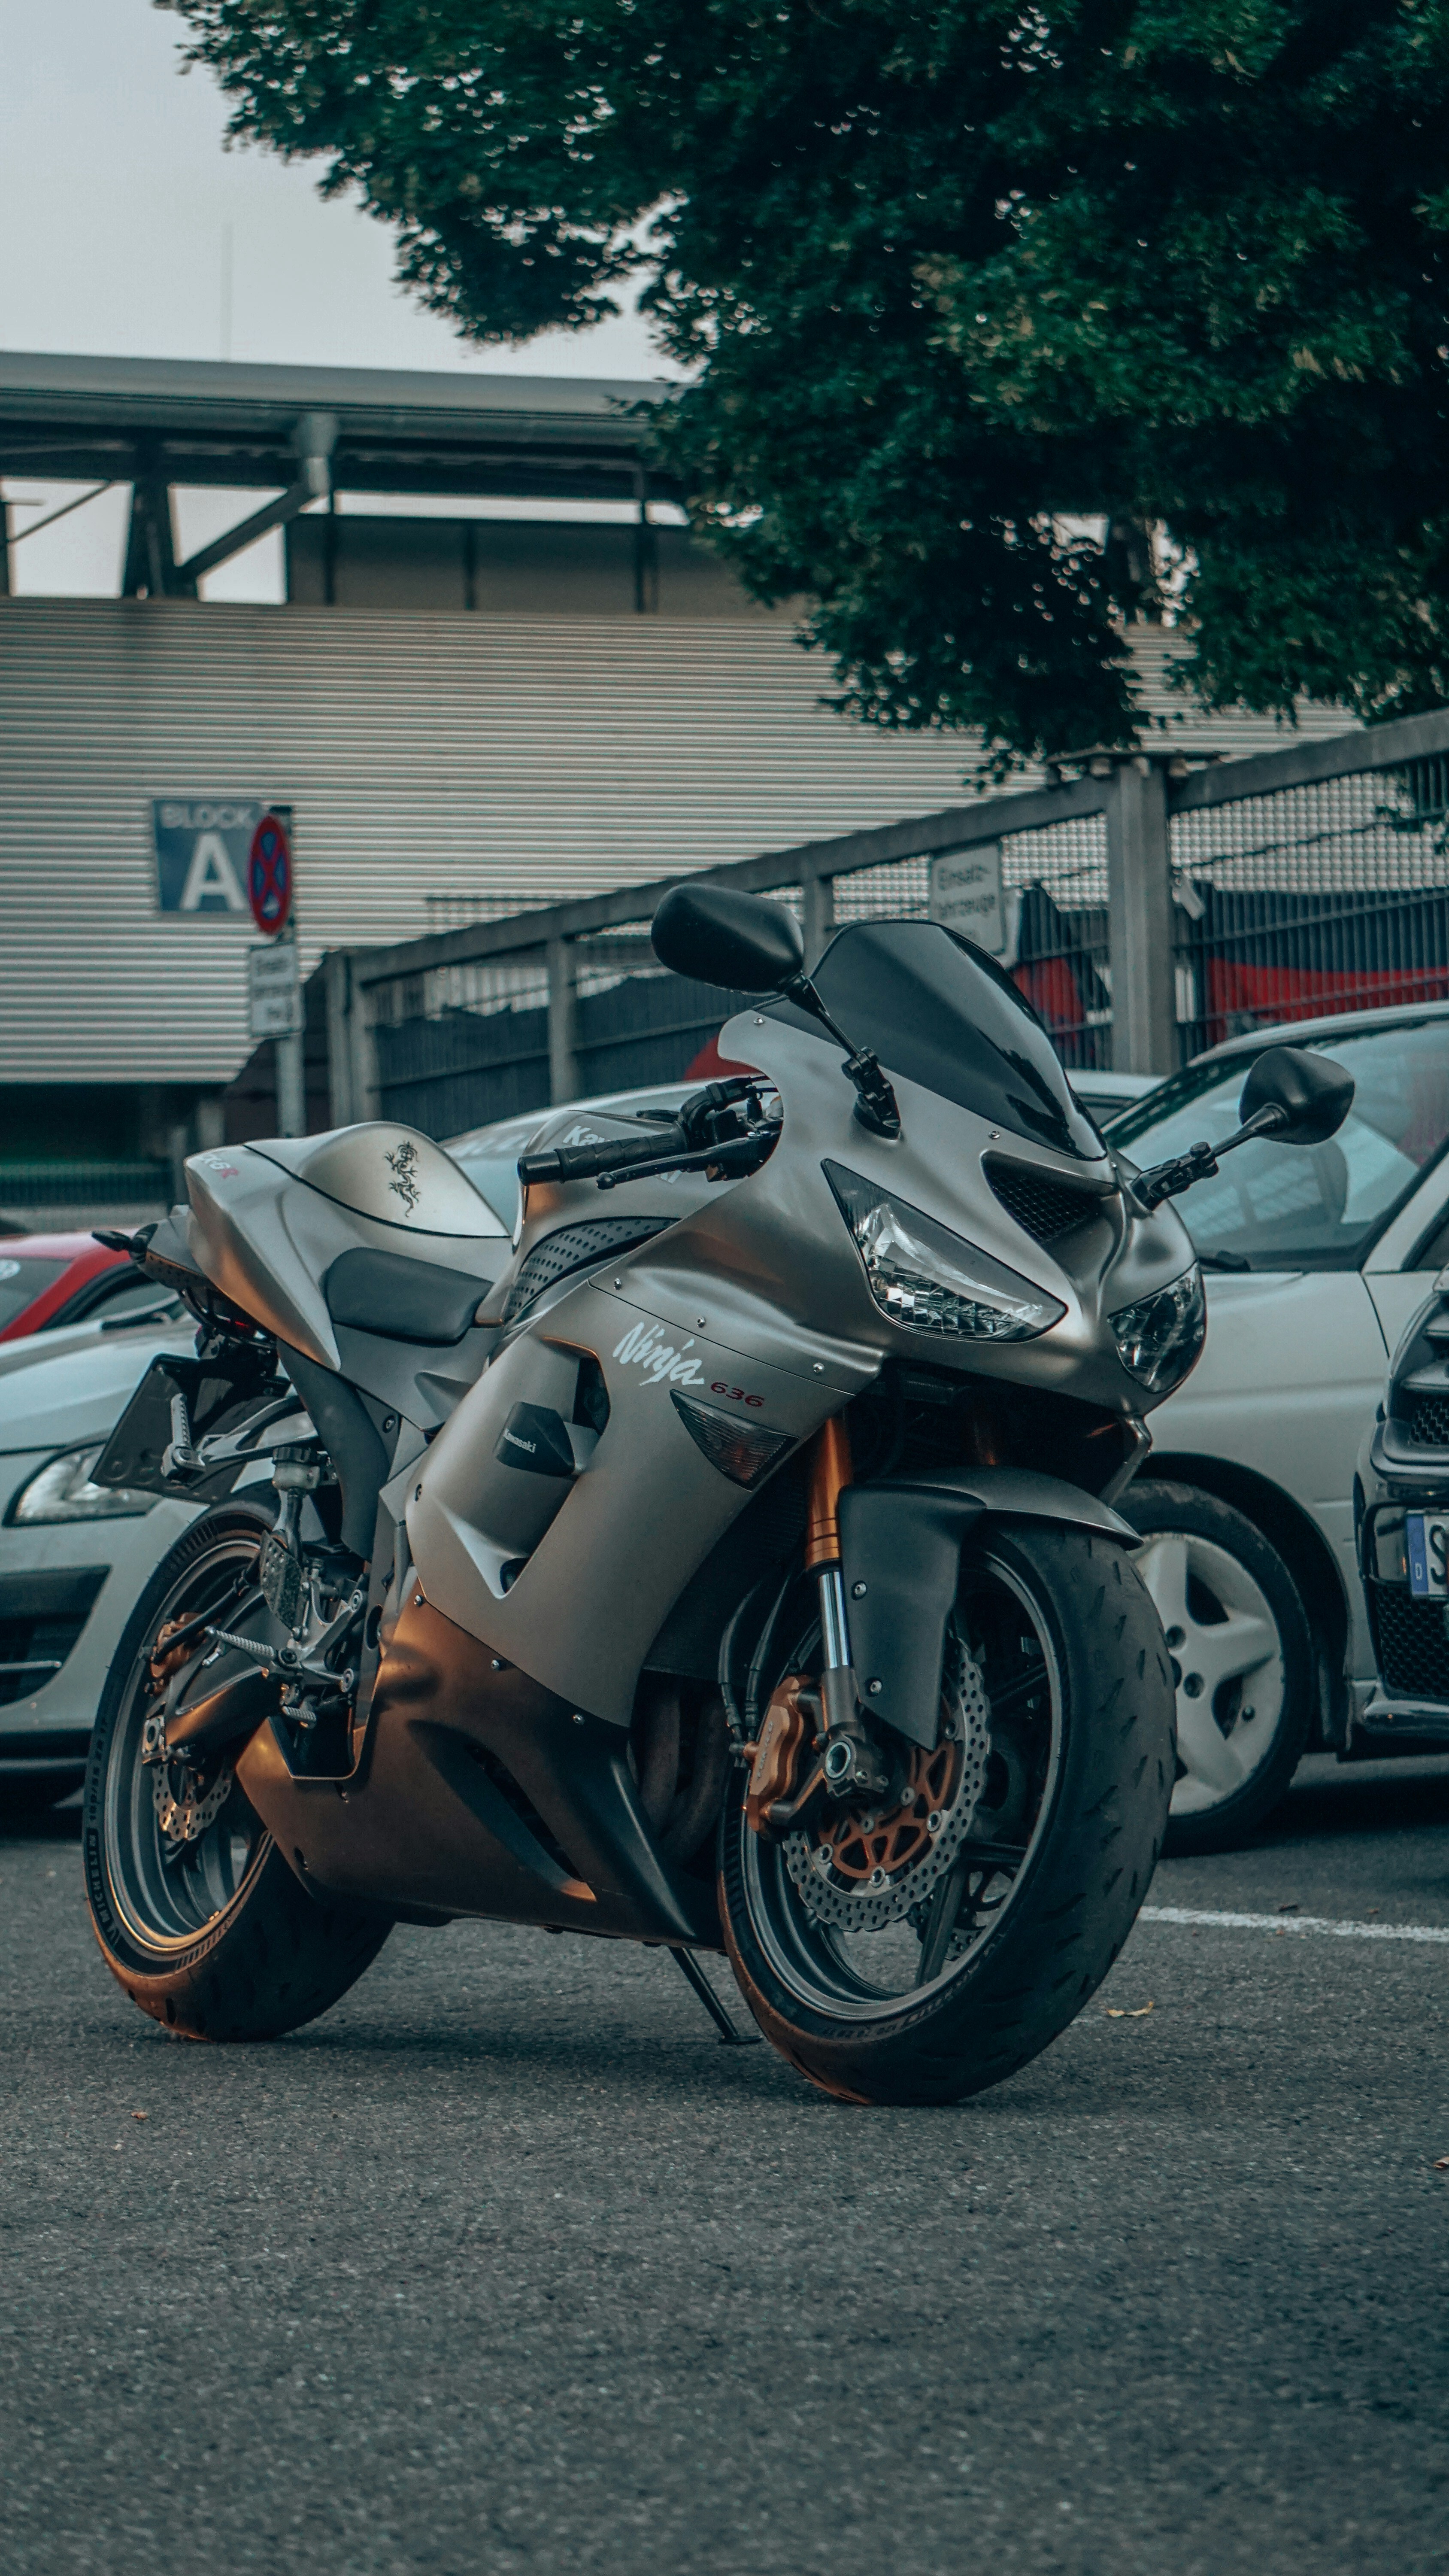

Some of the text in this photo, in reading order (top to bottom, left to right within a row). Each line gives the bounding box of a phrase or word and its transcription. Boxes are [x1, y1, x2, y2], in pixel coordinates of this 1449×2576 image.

[161, 804, 255, 829] BLOCK
[180, 834, 248, 909] A
[612, 1321, 705, 1386] Ninja
[711, 1382, 765, 1407] 636
[503, 1428, 537, 1453] Kawasaki
[1415, 1562, 1423, 1580] D
[89, 1835, 109, 1922] MICHELIN
